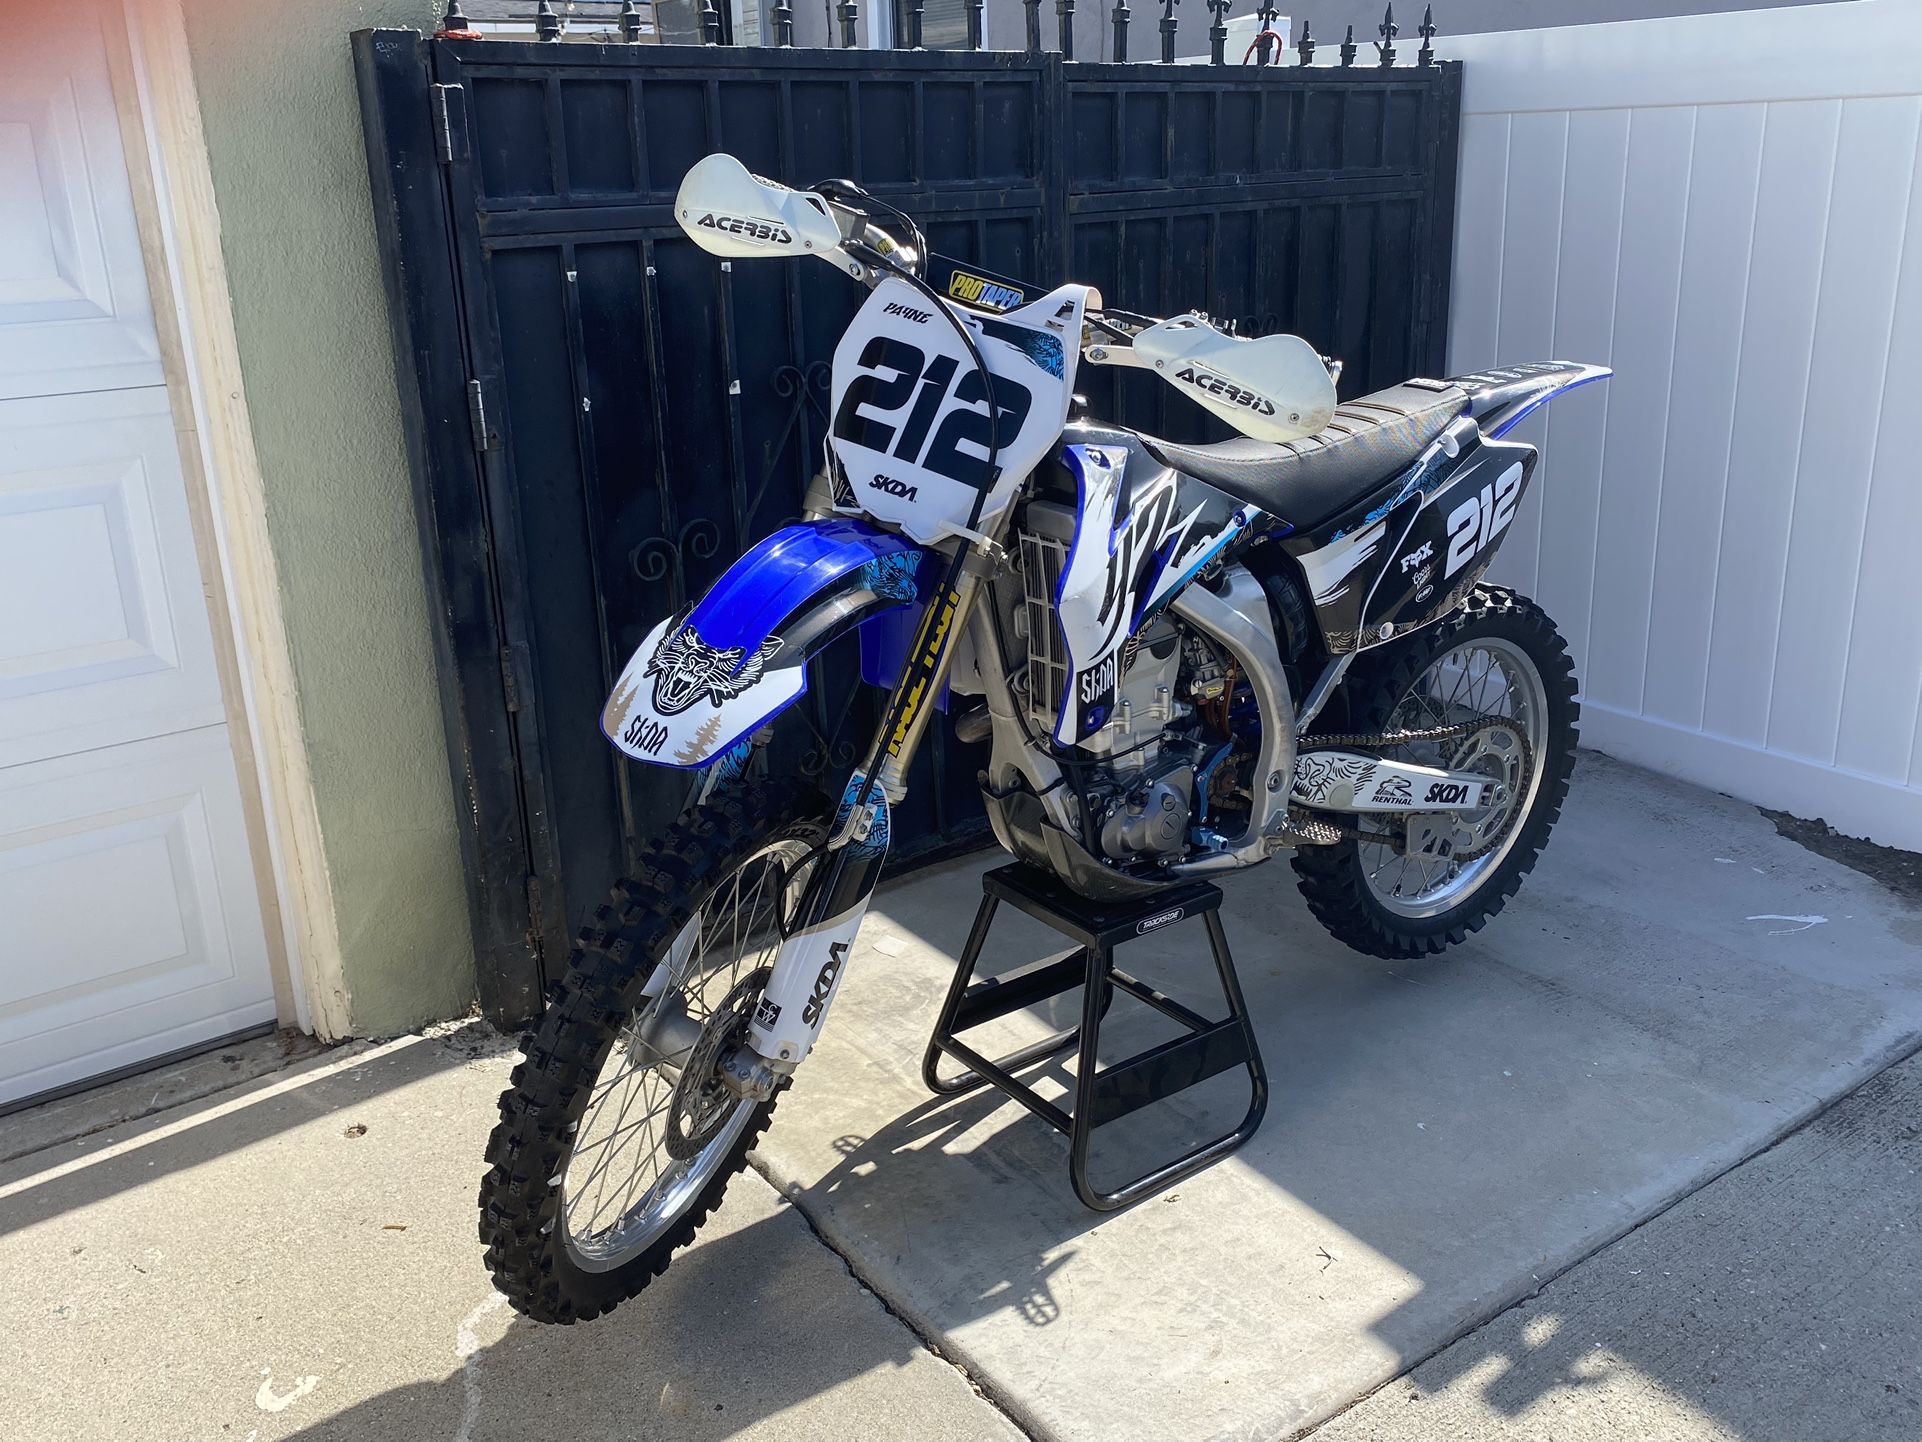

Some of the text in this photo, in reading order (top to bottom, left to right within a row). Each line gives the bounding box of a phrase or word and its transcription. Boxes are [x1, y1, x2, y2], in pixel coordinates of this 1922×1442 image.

[697, 213, 792, 244] ACERBIS
[883, 302, 934, 324] PAYNE
[1175, 368, 1276, 416] ACERBIS
[833, 336, 1033, 494] 212
[869, 475, 918, 502] SKDA
[1444, 461, 1524, 580] 212
[1372, 795, 1413, 805] RENTHAL
[1424, 783, 1470, 804] SKDA
[802, 941, 849, 1030] SKDA
